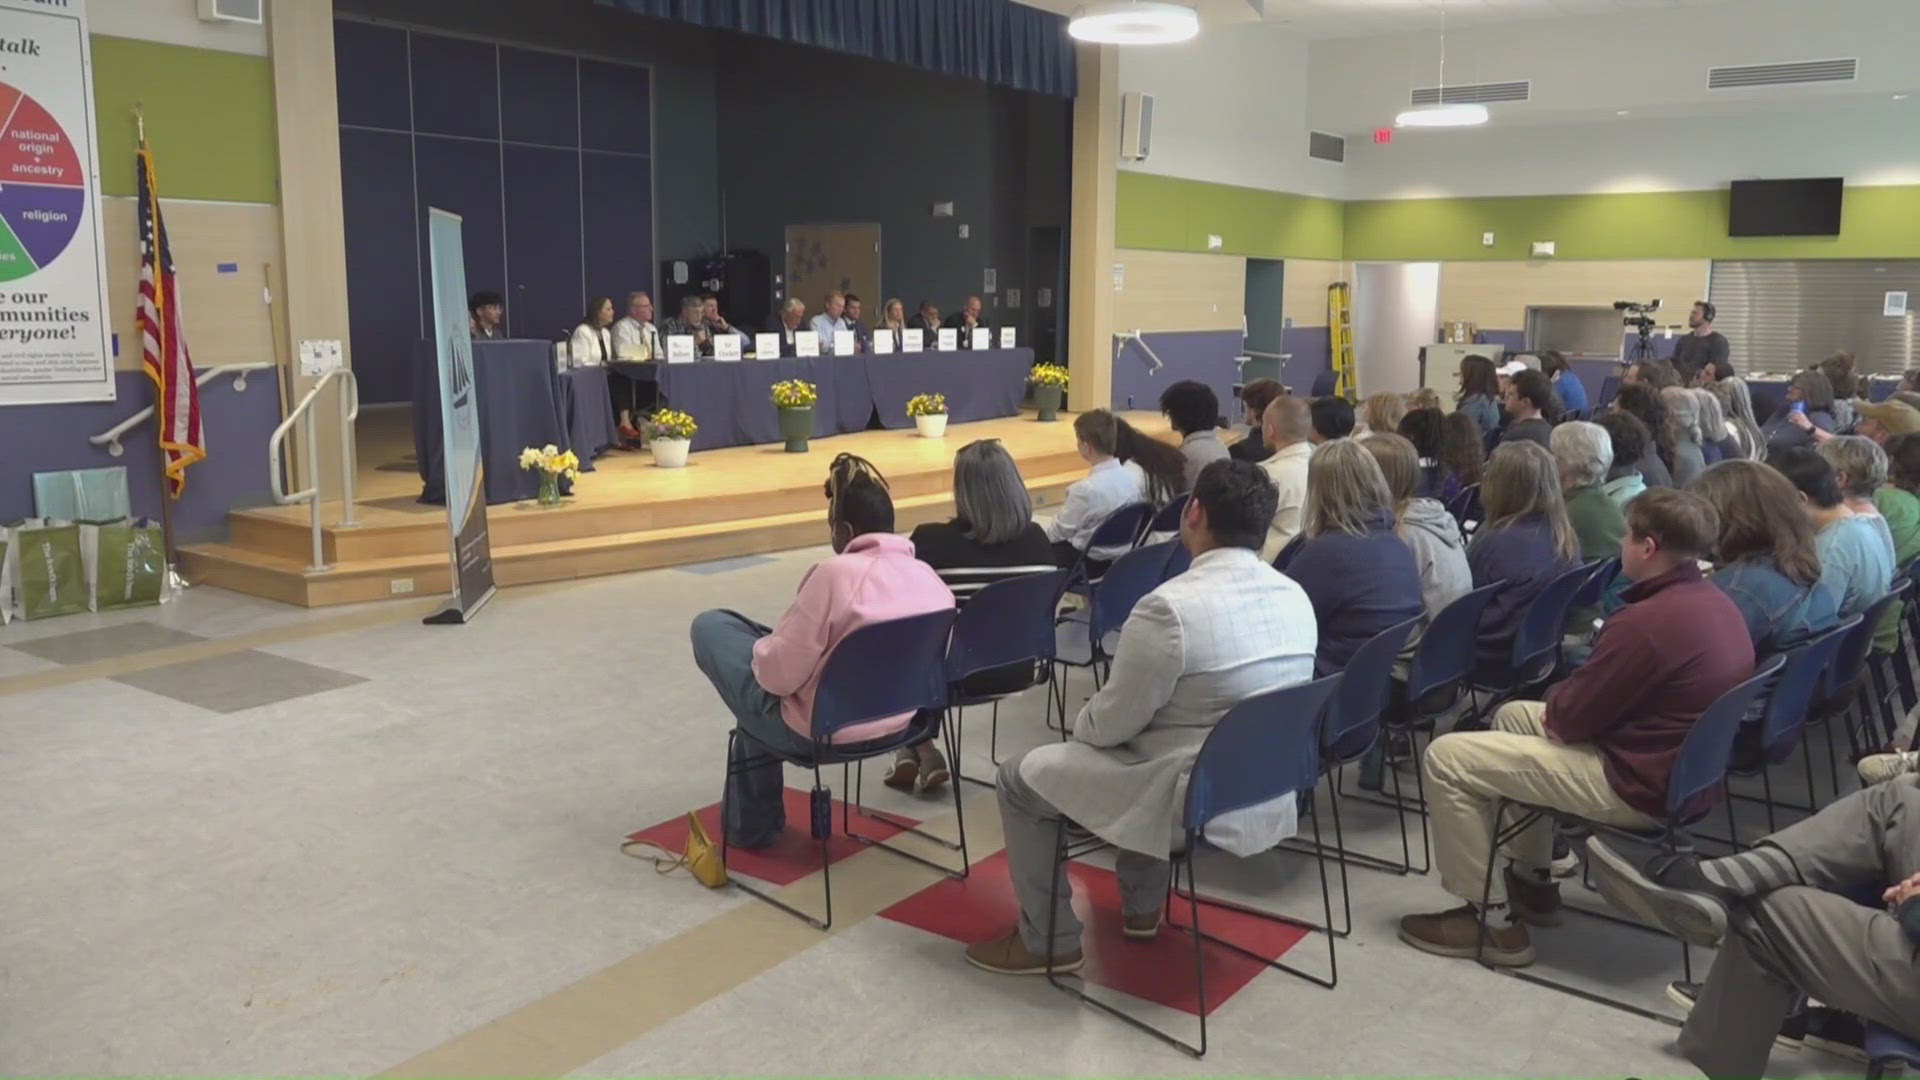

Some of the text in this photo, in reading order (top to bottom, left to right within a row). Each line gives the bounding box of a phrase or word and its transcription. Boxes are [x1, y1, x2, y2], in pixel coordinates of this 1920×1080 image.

[11, 129, 59, 142] national
[19, 143, 54, 155] origin
[12, 164, 64, 177] ancestry
[22, 210, 68, 222] religion
[12, 292, 48, 304] our
[0, 306, 90, 322] munities
